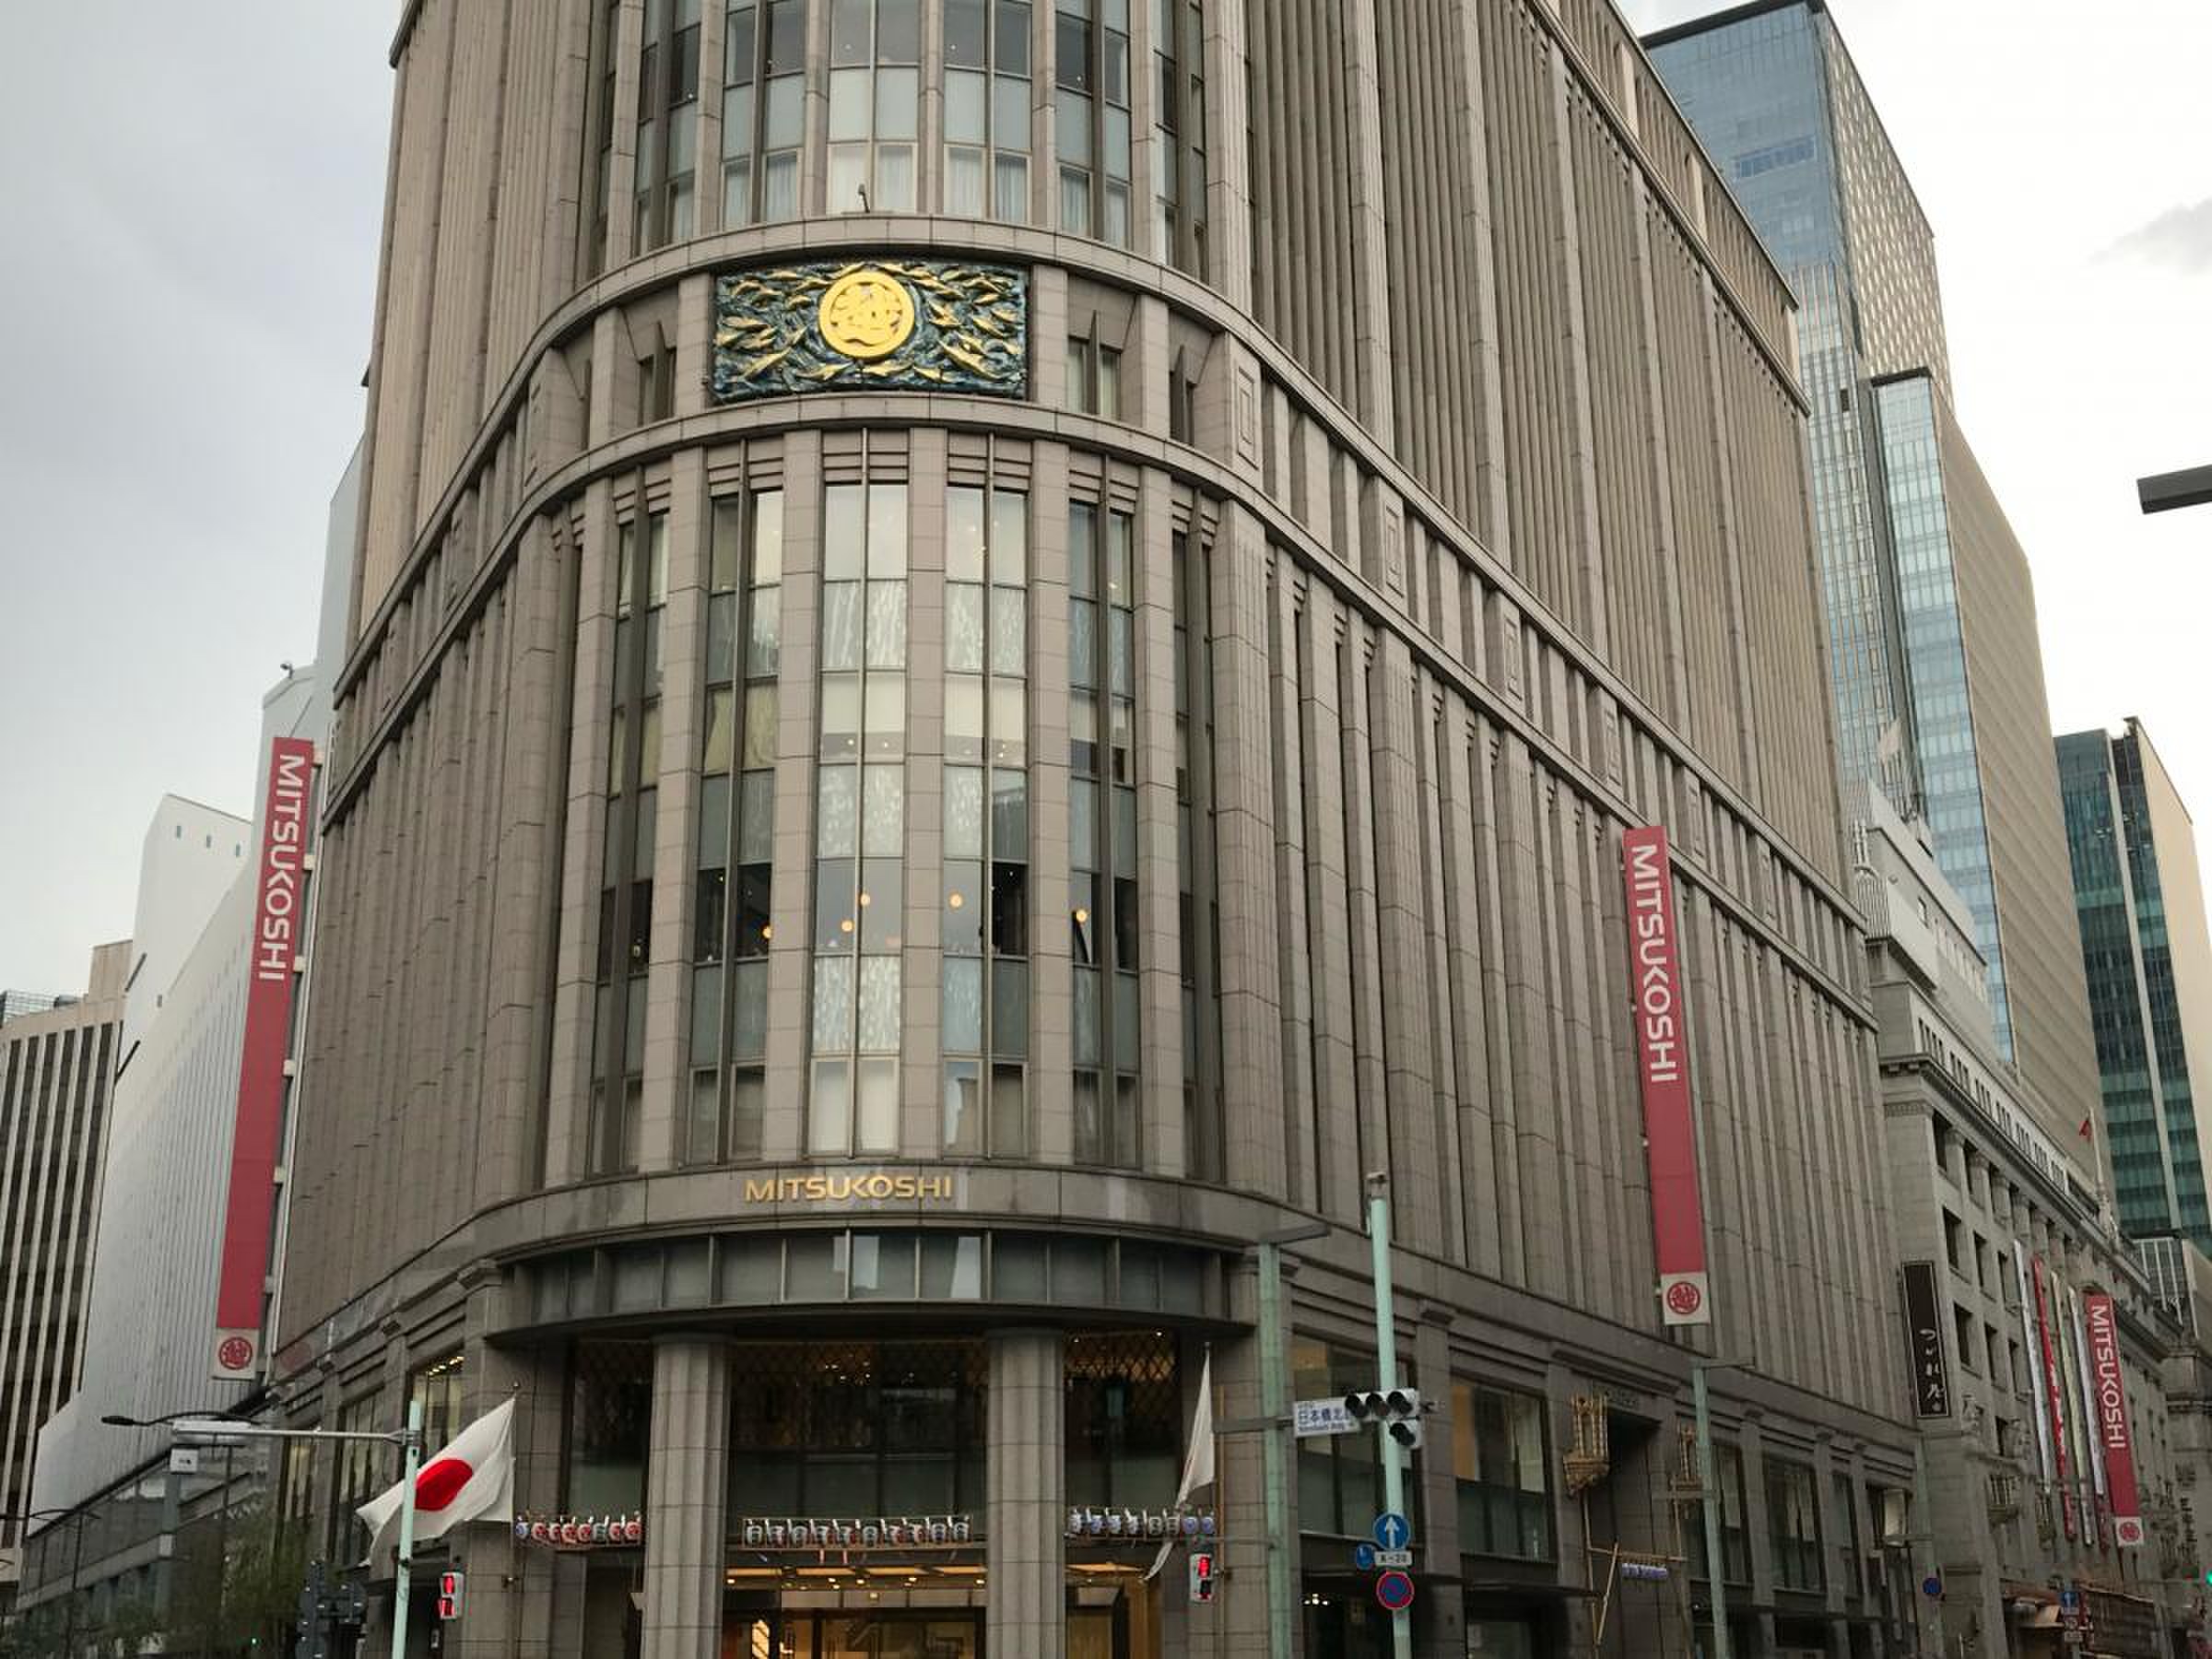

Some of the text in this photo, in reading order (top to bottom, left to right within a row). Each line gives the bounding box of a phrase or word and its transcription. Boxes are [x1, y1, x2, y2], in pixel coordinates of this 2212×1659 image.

[259, 753, 305, 981] MITSUKOSHI
[1631, 843, 1677, 1082] MITSUKOSHI
[745, 1175, 951, 1202] MITSUKOSHI
[2091, 1304, 2126, 1449] MITSUKOSHI
